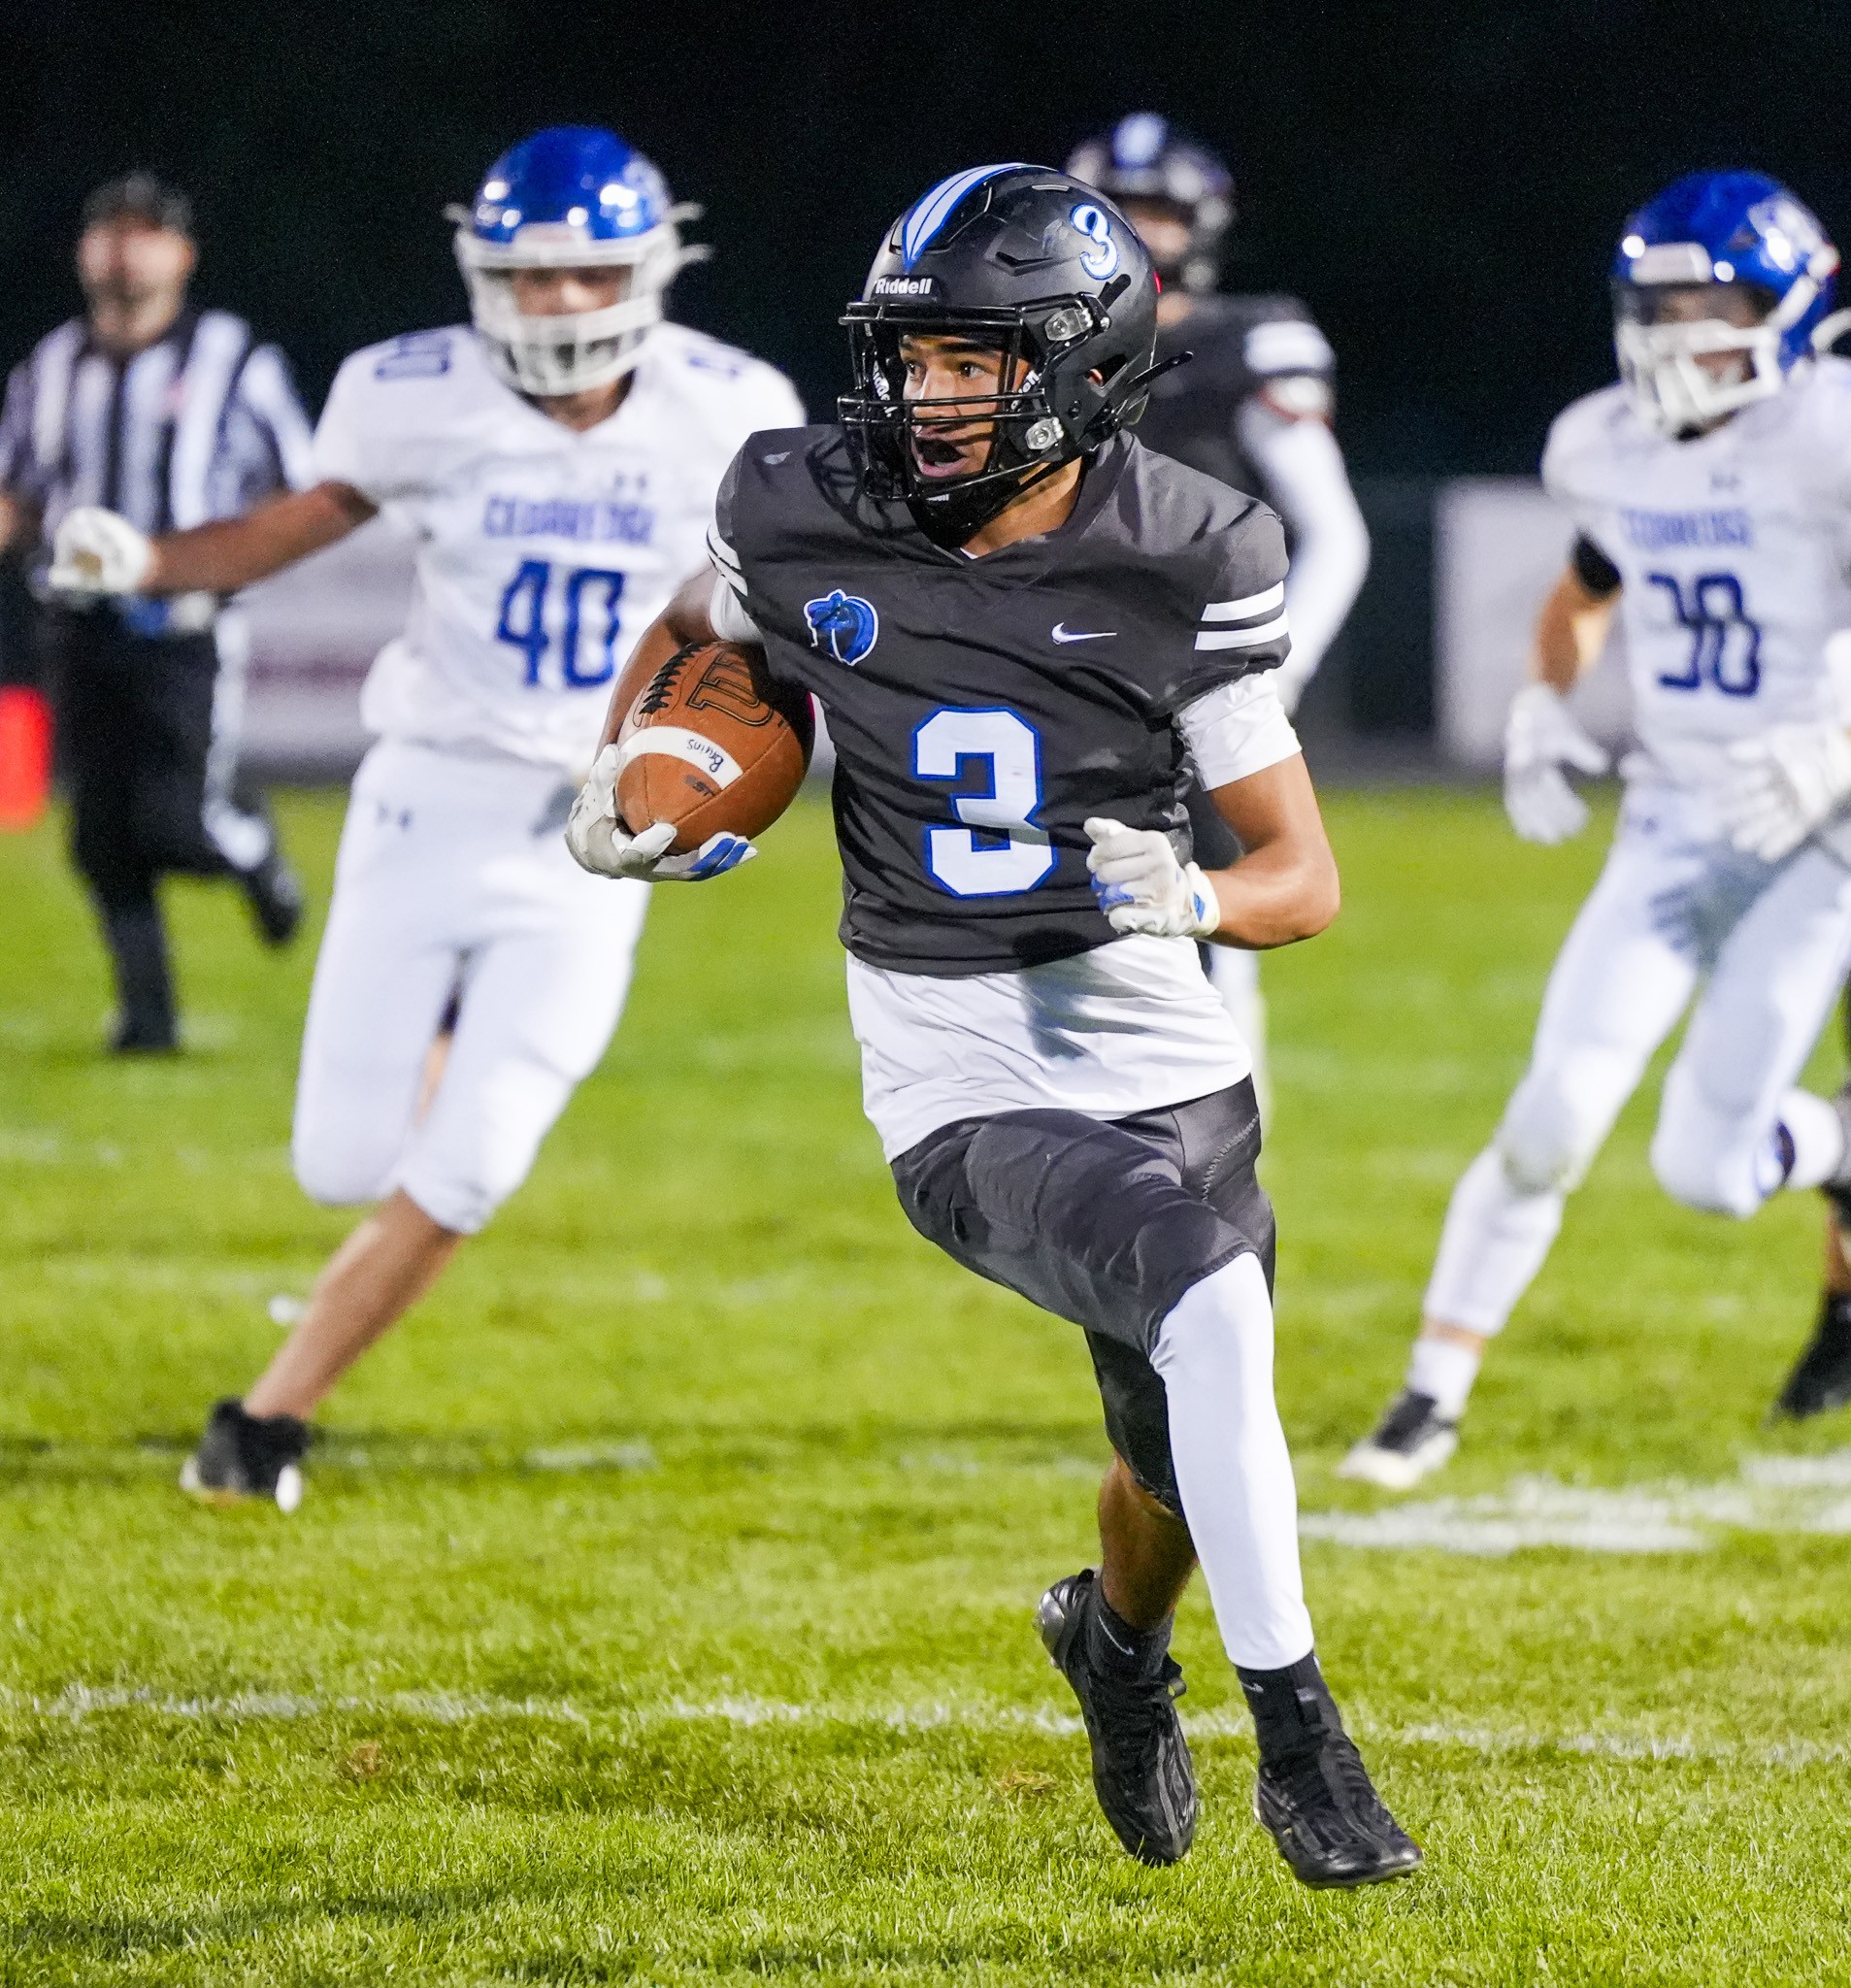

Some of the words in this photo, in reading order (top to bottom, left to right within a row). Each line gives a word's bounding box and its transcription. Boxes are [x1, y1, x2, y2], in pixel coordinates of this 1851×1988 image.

[1070, 203, 1121, 281] 3
[875, 277, 933, 295] Riddell
[497, 559, 626, 689] 40
[686, 738, 724, 774] Bruins
[911, 705, 1058, 899] 3
